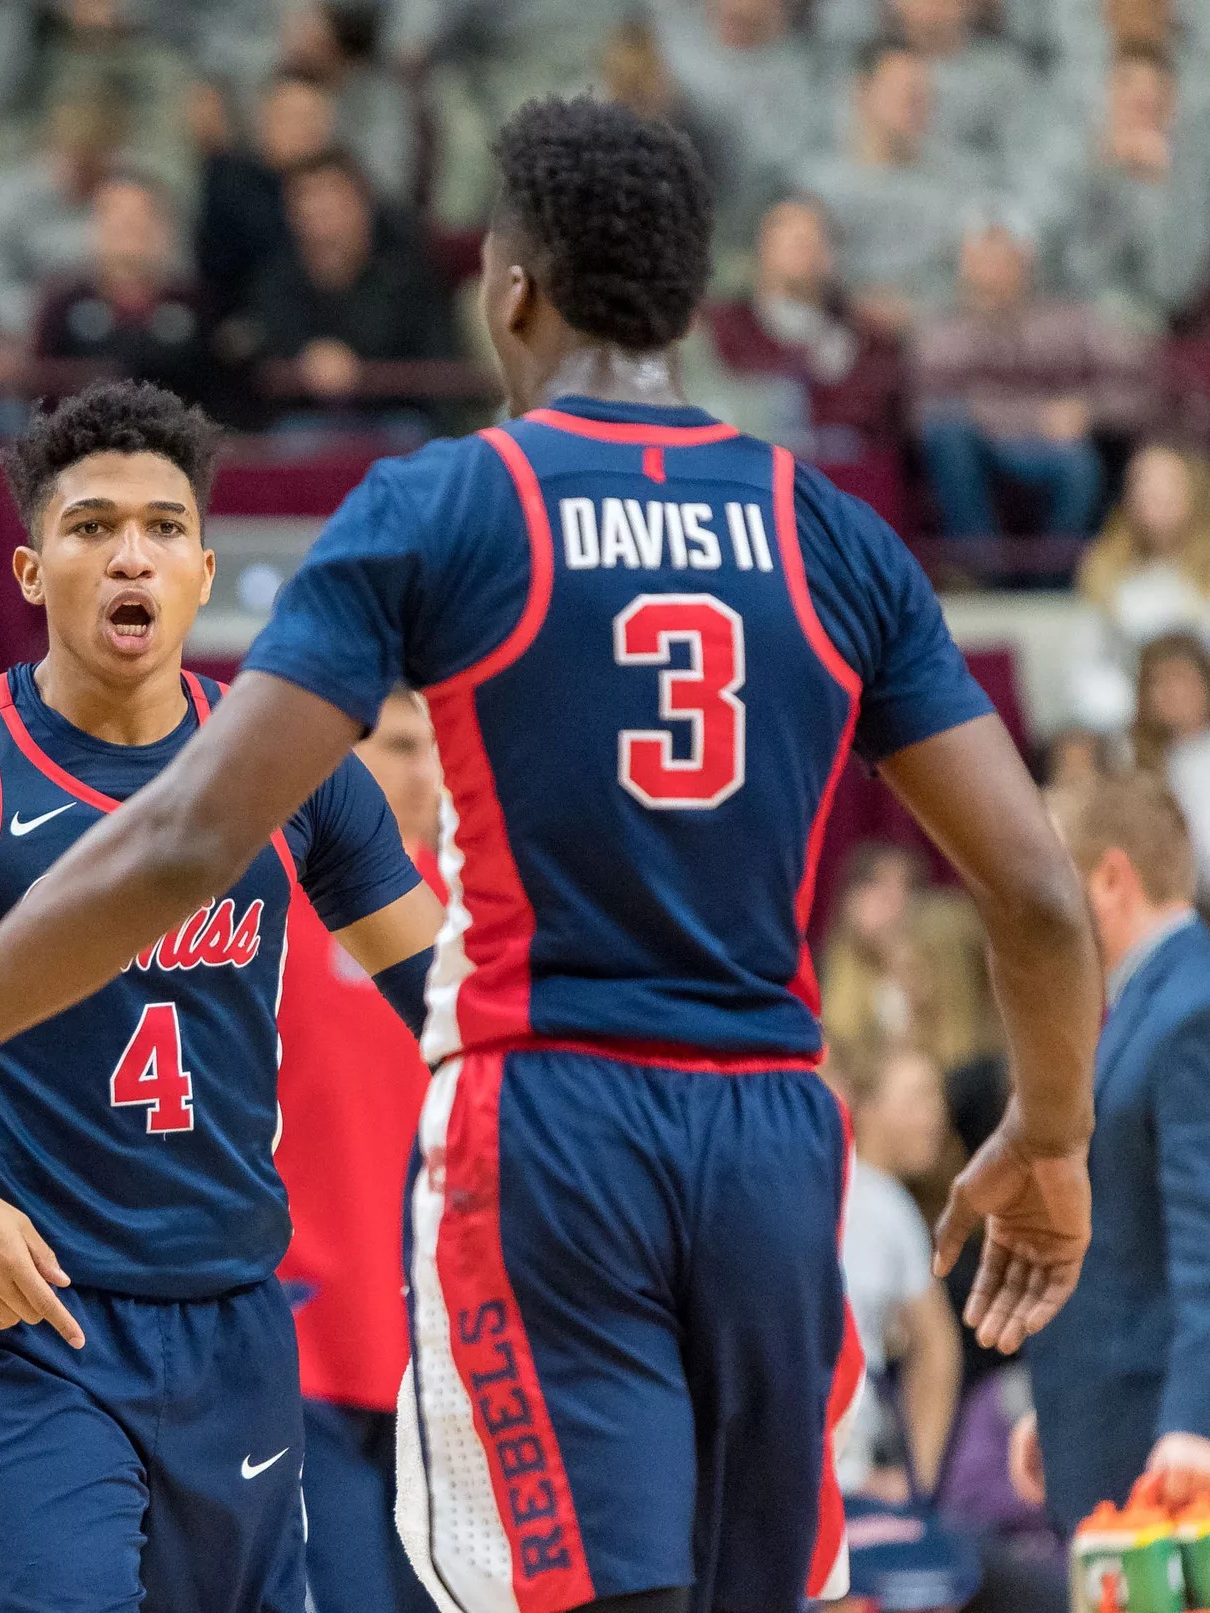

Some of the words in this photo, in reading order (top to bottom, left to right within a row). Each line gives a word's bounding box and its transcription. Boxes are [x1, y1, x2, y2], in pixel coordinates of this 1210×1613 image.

[559, 496, 722, 572] DAVIS
[725, 502, 773, 573] II
[613, 592, 746, 811] 3
[110, 1001, 194, 1135] 4
[458, 1298, 571, 1580] REBELS
